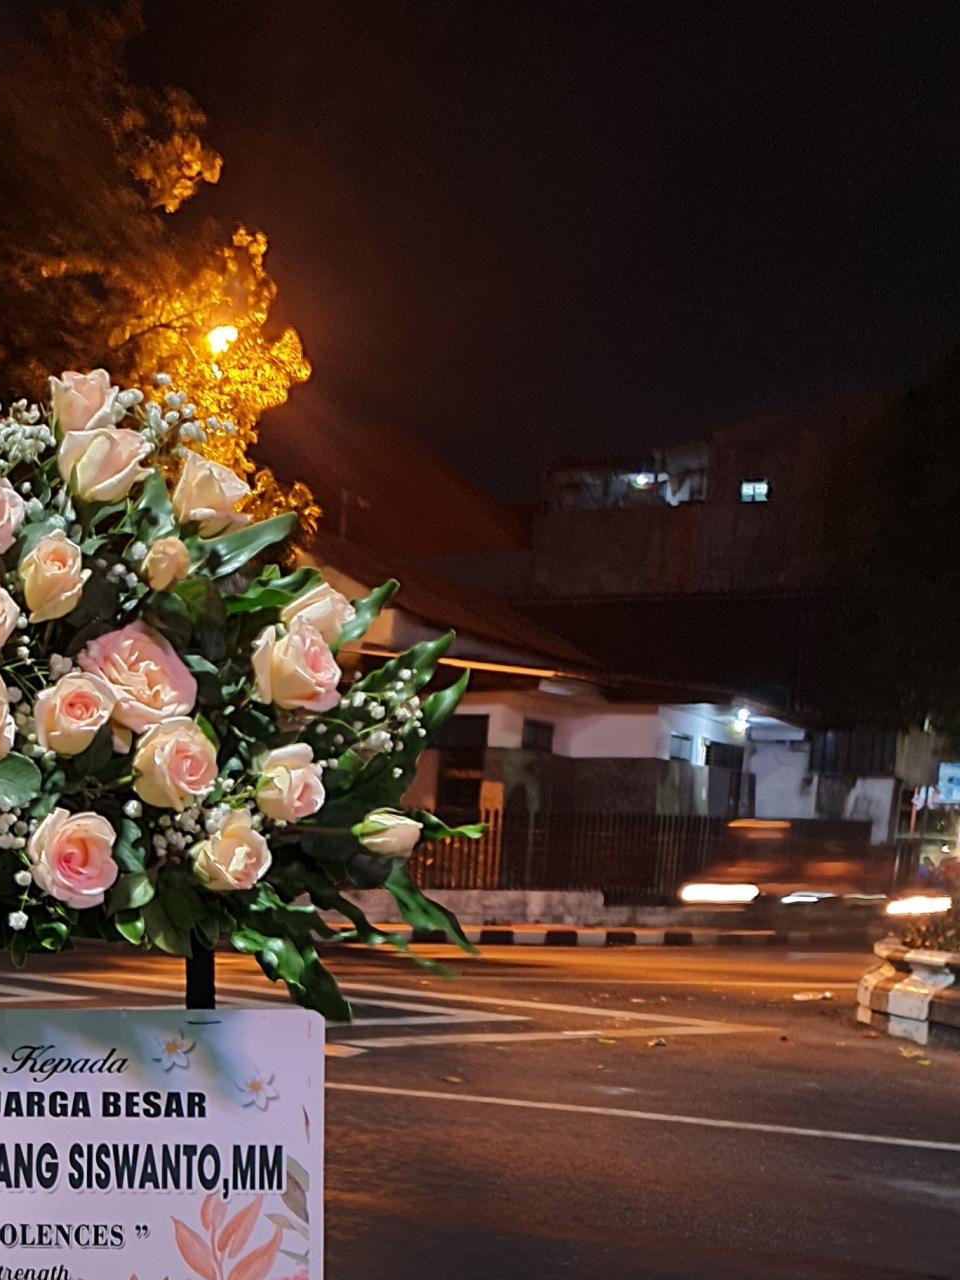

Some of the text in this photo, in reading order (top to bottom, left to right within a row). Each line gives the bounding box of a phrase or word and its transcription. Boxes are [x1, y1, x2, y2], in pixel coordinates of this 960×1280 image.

[2, 1045, 128, 1082] Kepada
[101, 1092, 206, 1118] BESAR
[68, 1143, 283, 1199] SISWANTO,MM
